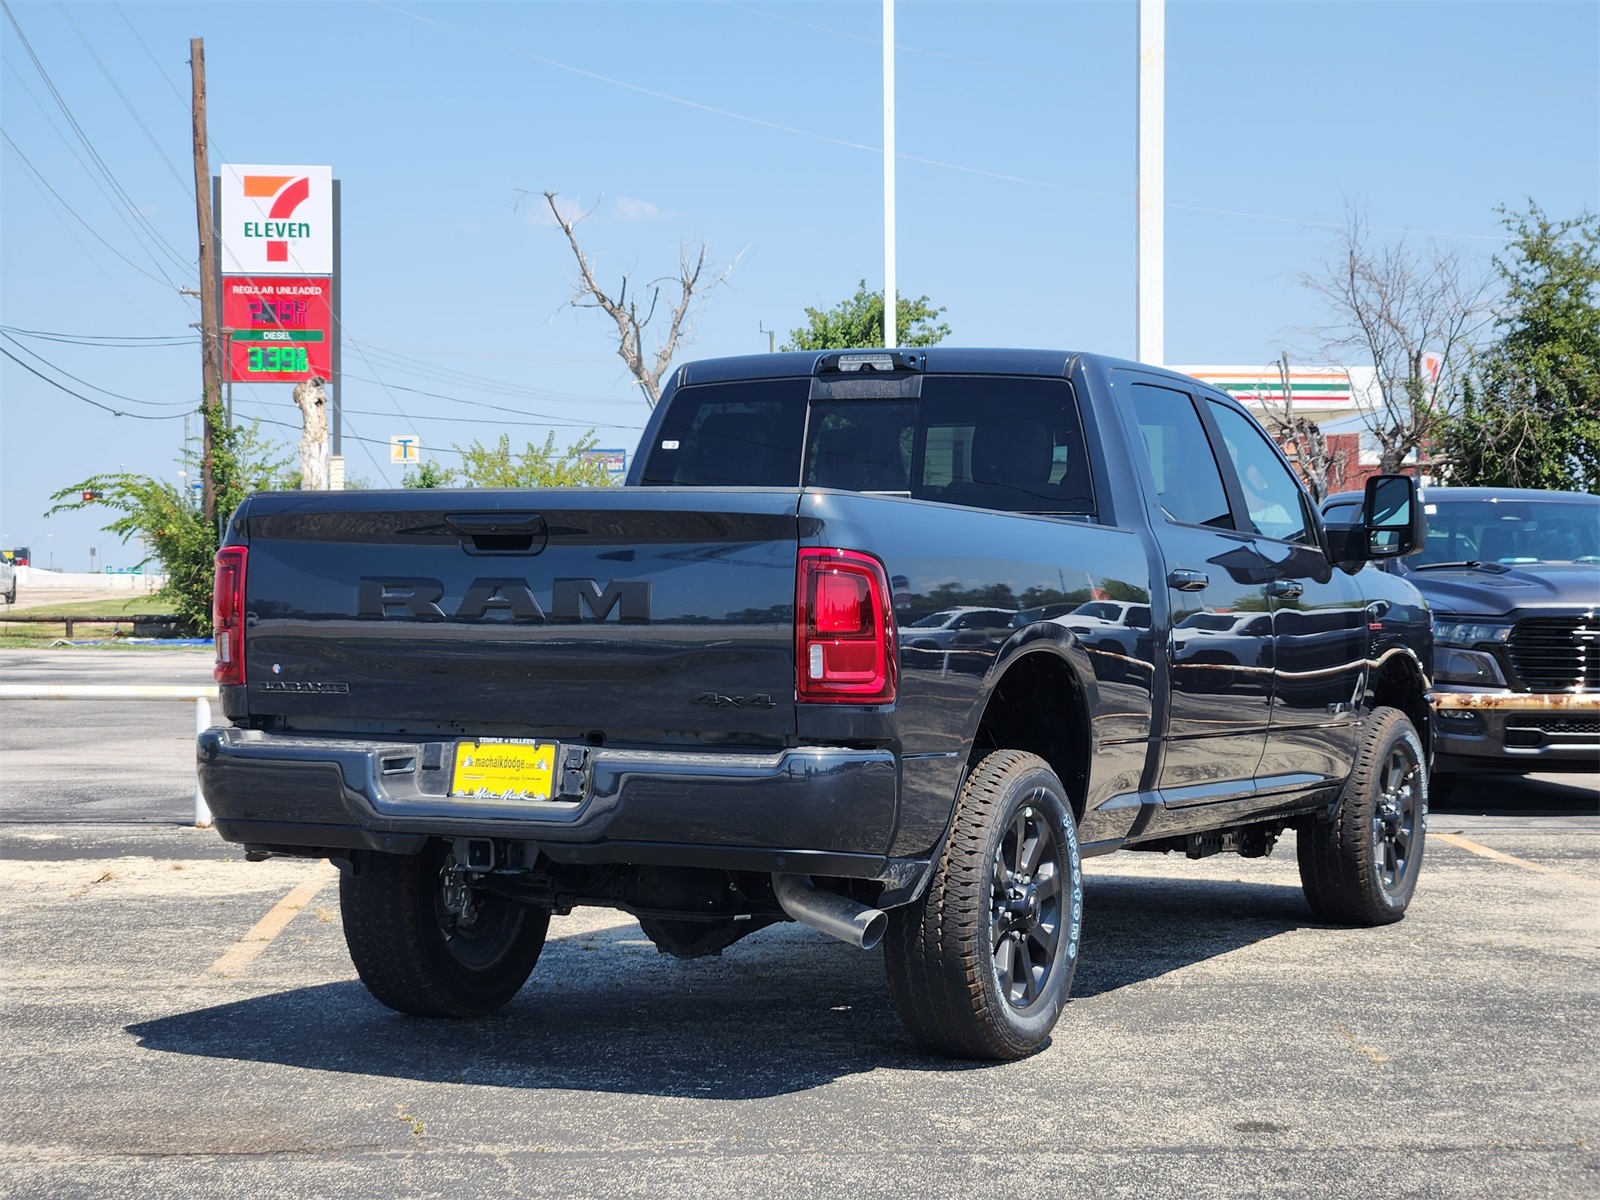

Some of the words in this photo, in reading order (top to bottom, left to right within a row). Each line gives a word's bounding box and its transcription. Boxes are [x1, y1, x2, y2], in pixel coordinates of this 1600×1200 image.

[244, 175, 309, 219] 7
[233, 285, 274, 294] REGULAR
[276, 286, 322, 295] UNLEADED
[263, 331, 291, 340] DIESEL
[357, 576, 653, 623] RAM
[474, 787, 498, 800] Mac
[500, 788, 528, 801] Haik
